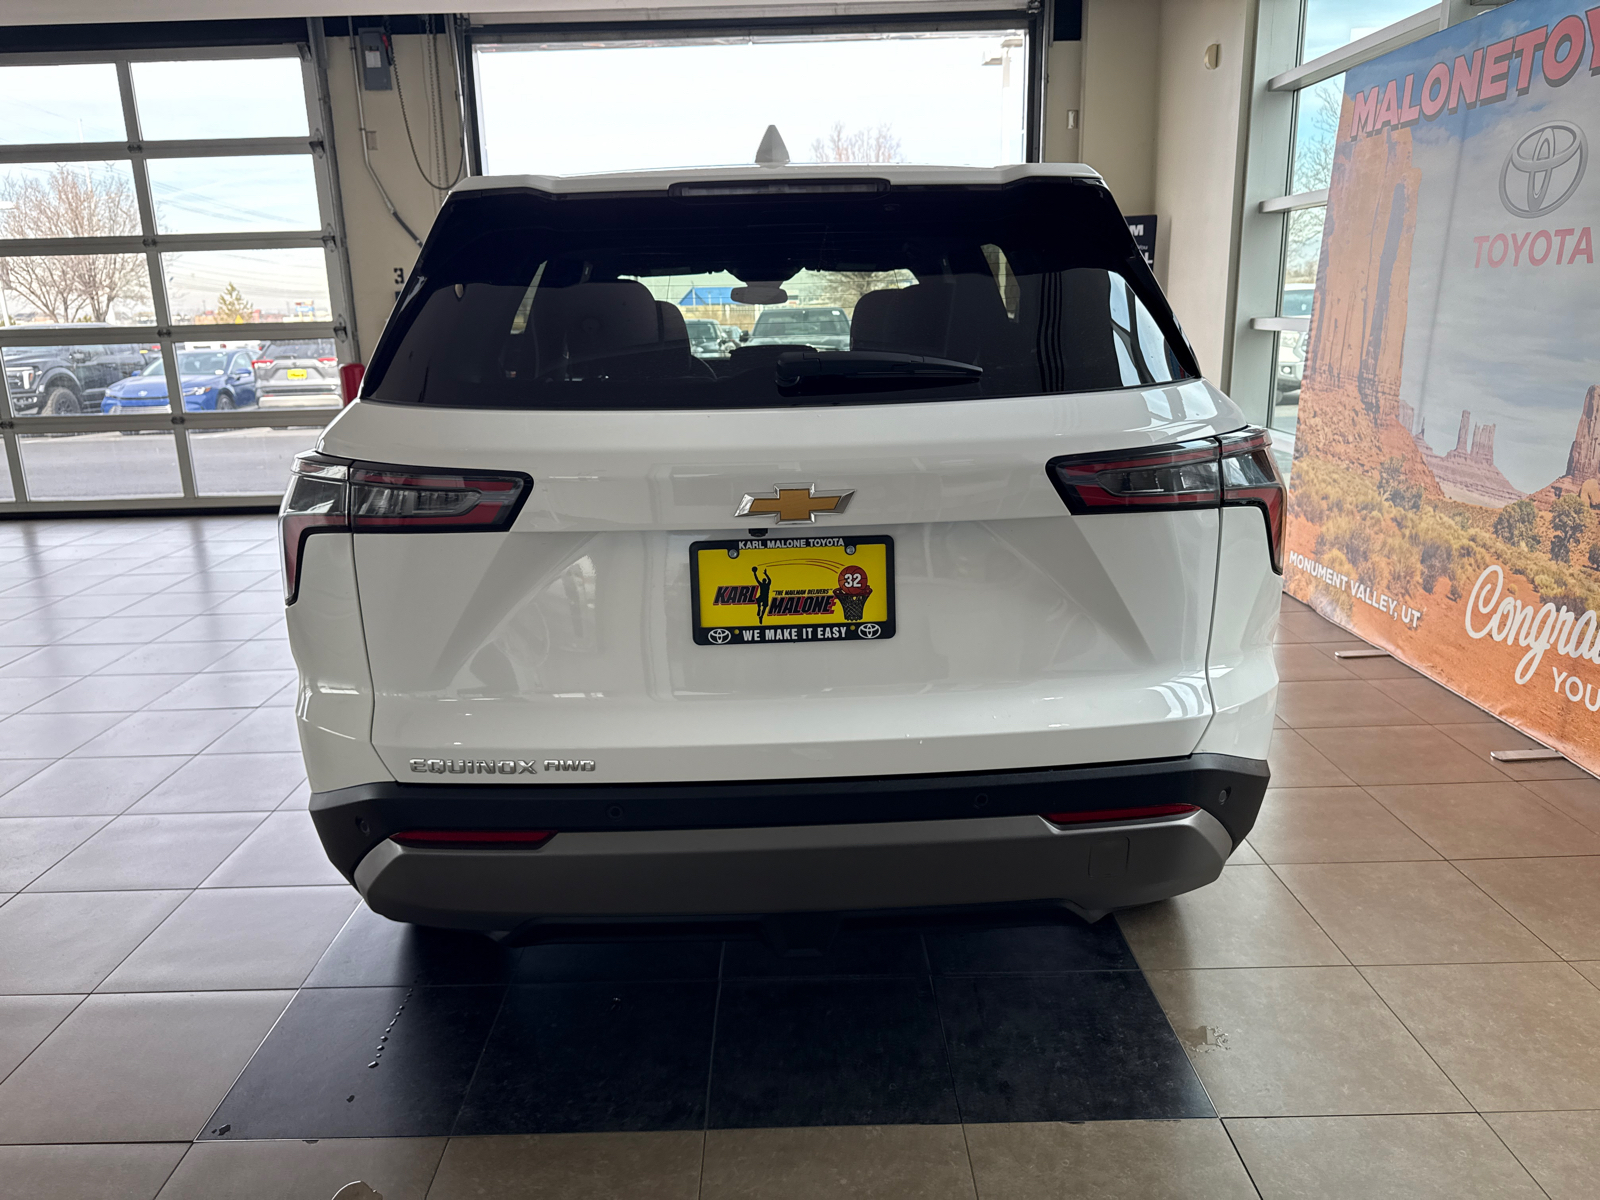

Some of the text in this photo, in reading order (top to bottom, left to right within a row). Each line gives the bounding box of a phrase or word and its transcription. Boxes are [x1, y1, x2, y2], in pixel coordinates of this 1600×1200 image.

[1473, 226, 1594, 269] TOYOTA
[739, 538, 845, 549] KARL MALONE TOYOTA
[844, 574, 862, 588] 32
[1289, 550, 1421, 628] MONUMENT VALLEY, UT
[713, 585, 760, 606] KARL
[767, 595, 837, 616] MALONE
[743, 626, 847, 641] WE MAKE IT EASY
[409, 758, 596, 775] EQUINOX AWD
